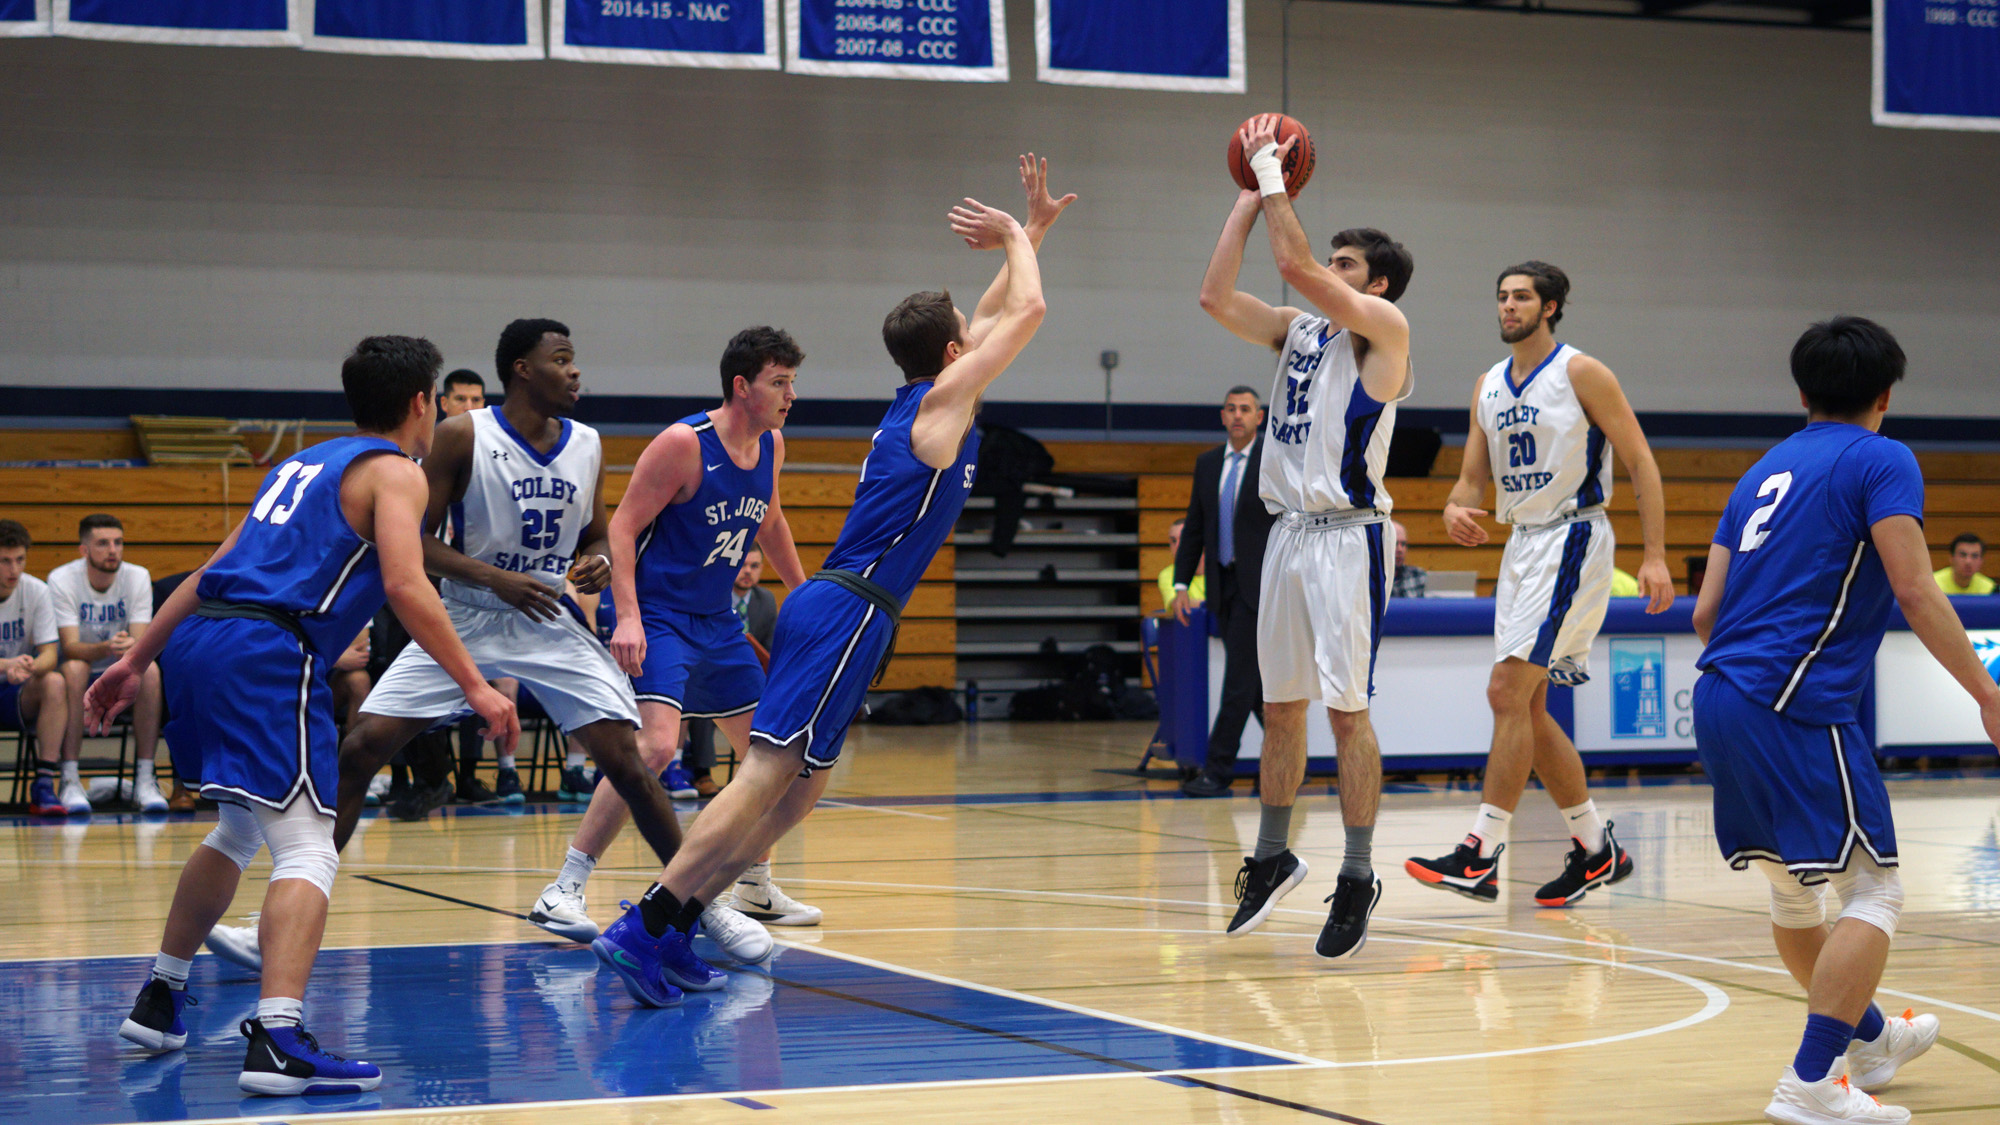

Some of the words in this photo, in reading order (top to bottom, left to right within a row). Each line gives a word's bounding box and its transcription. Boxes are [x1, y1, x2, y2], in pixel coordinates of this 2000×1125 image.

[600, 0, 673, 20] 2014-15
[687, 2, 731, 22] NAC
[1967, 8, 1999, 27] CCC
[835, 13, 904, 33] 2005-06
[917, 16, 958, 36] CCC
[835, 37, 904, 57] 2007-08
[917, 40, 958, 60] CCC
[1496, 405, 1540, 431] COLBY
[1508, 430, 1537, 468] 20
[252, 459, 326, 526] 13
[511, 476, 577, 504] COLBY
[705, 500, 732, 526] ST.
[734, 496, 769, 524] JOES
[1738, 470, 1793, 553] 2
[521, 508, 564, 551] 25
[703, 528, 749, 568] 24
[99, 599, 126, 622] JOS
[0, 617, 25, 640] OES
[1674, 689, 1694, 712] C
